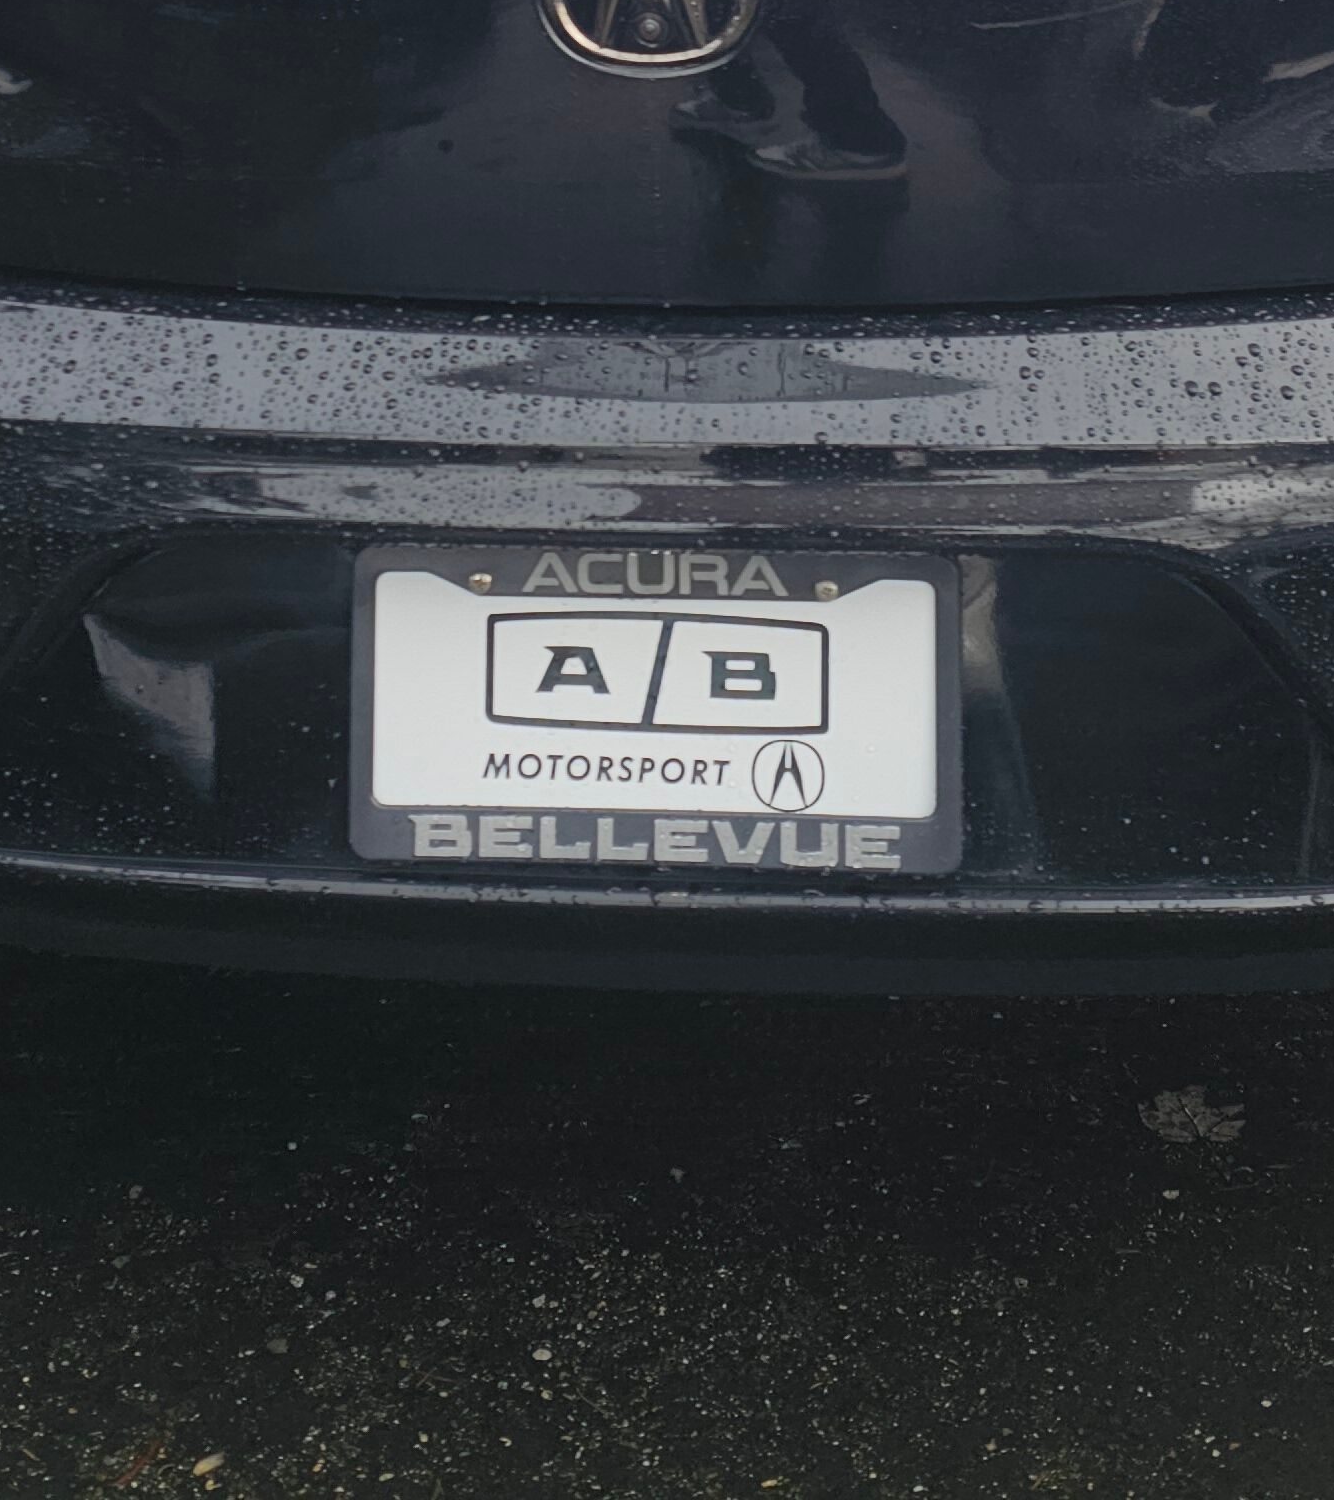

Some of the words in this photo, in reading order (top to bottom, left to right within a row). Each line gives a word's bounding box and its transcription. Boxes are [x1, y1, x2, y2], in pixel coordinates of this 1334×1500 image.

[522, 551, 789, 596] ACURA
[536, 646, 610, 695] A
[702, 651, 776, 700] B
[483, 753, 731, 787] MOTORSPORT
[407, 813, 903, 870] BELLEVUE
